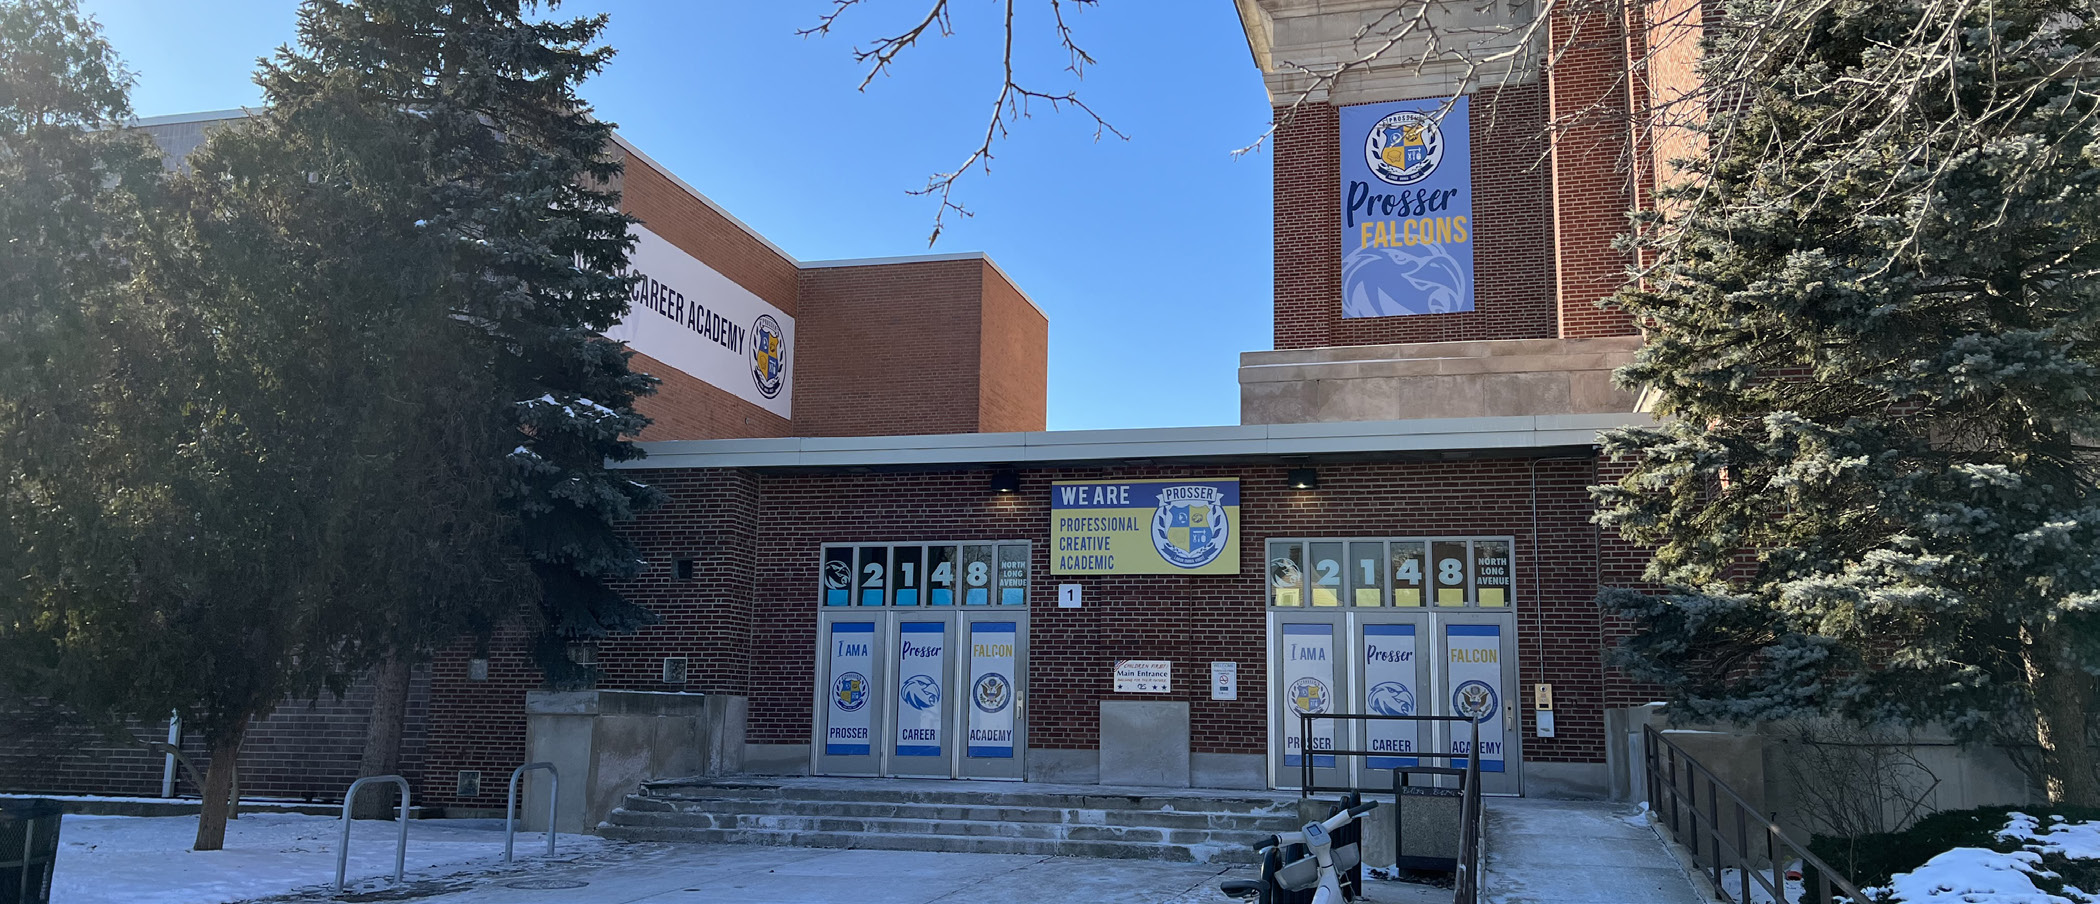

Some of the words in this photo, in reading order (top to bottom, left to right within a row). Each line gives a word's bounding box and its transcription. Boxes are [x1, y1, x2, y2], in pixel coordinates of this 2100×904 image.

[1347, 180, 1458, 228] Prosser
[1361, 215, 1468, 249] FALCONS
[630, 268, 684, 326] CAREER
[687, 300, 746, 355] ACADEMY
[1061, 487, 1088, 506] WE
[1093, 485, 1130, 505] ARE
[1166, 487, 1213, 500] PROSSER
[1060, 517, 1139, 531] PROFESSIONAL
[1059, 536, 1111, 551] CREATIVE
[1001, 561, 1026, 569] NORTH
[1059, 555, 1115, 570] ACADEMIC
[1478, 557, 1507, 566] NORTH
[861, 562, 884, 587] 2
[901, 562, 915, 587] 1
[931, 561, 953, 586] 4
[966, 561, 988, 587] 8
[1316, 558, 1341, 586] 2
[1360, 559, 1375, 585] 1
[1395, 558, 1422, 585] 4
[1438, 558, 1463, 586] 8
[1481, 567, 1505, 576] LONG
[1000, 579, 1027, 587] AVENUE
[1477, 576, 1510, 586] AVENUE
[1067, 589, 1073, 601] 1
[837, 640, 844, 658] I
[845, 644, 861, 656] AM
[862, 644, 868, 656] A
[902, 640, 942, 660] Prosser
[973, 644, 1013, 657] FALCON
[1291, 643, 1298, 662] I
[1300, 647, 1317, 661] AM
[1318, 647, 1326, 661] A
[1367, 644, 1413, 665] Prosser
[1451, 648, 1497, 663] FALCON
[830, 727, 868, 739] PROSSER
[902, 728, 936, 741] CAREER
[970, 729, 1012, 742] ACADEMY
[1372, 739, 1411, 752] CAREER
[1452, 740, 1501, 754] ACAEMY
